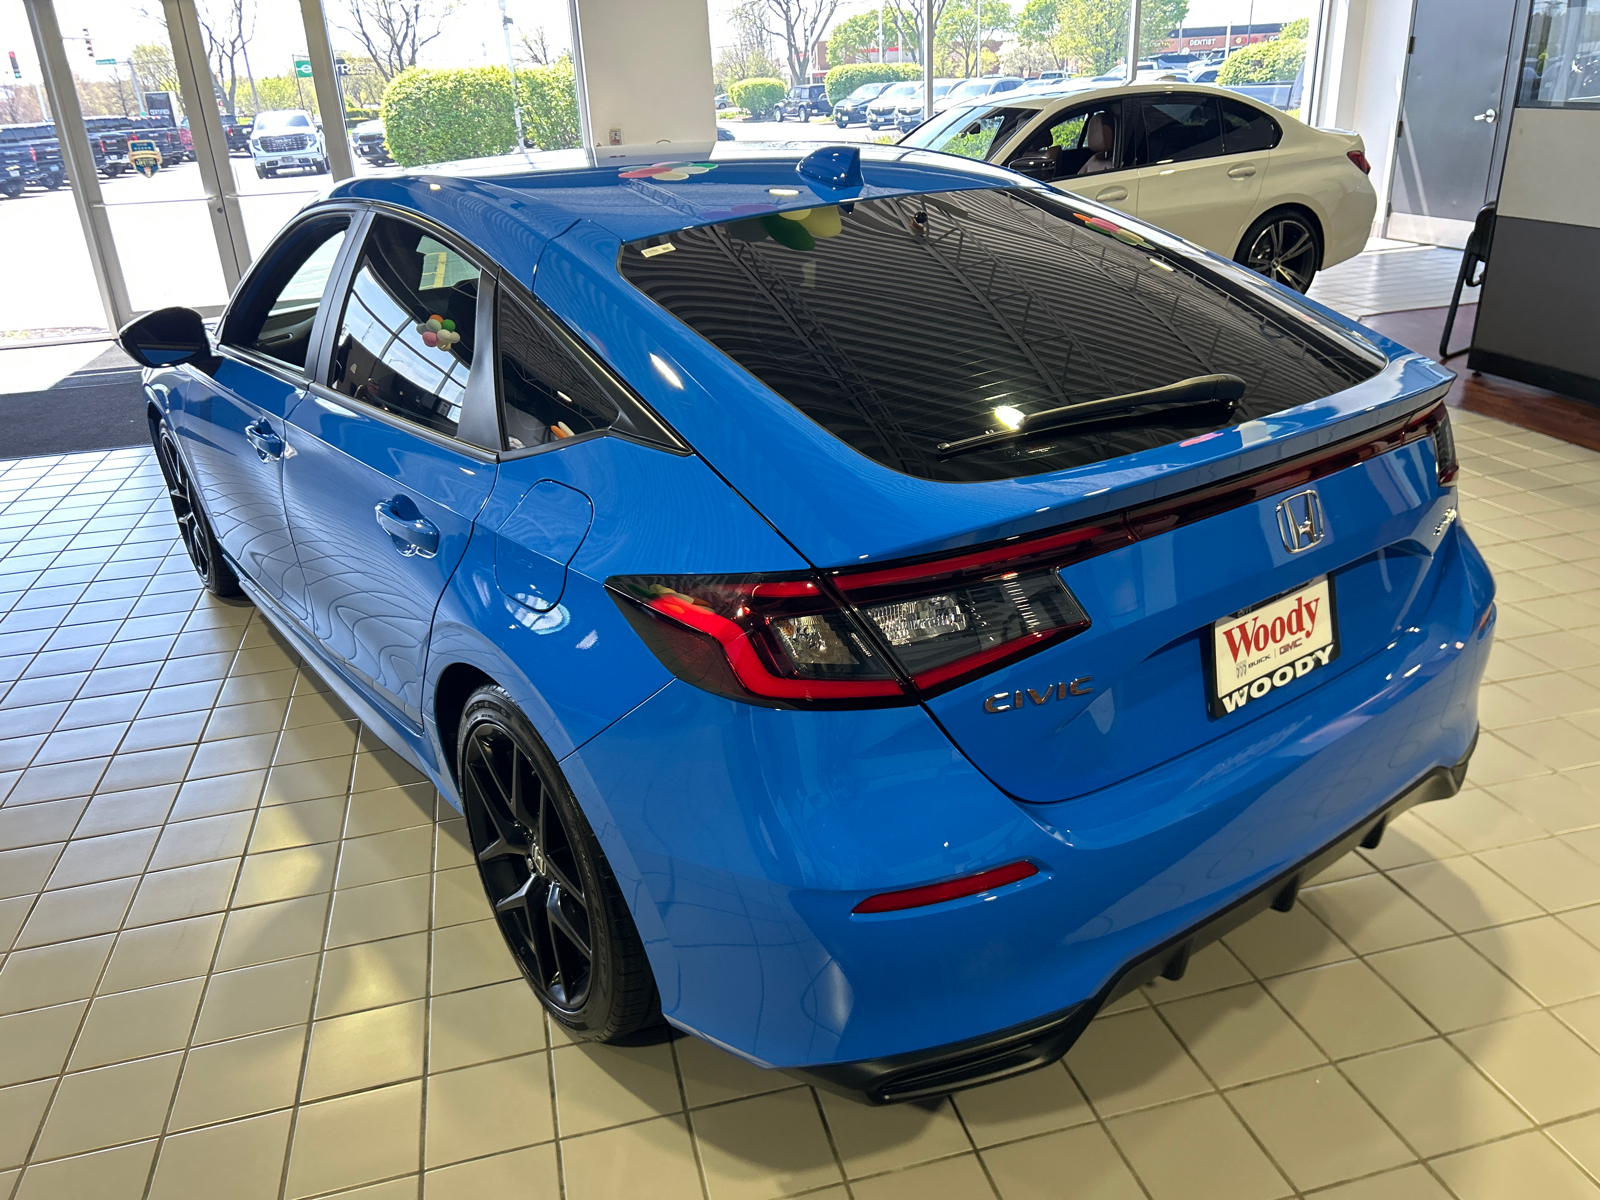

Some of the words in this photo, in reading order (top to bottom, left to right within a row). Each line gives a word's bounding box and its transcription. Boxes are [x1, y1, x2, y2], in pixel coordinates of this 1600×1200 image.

[1189, 38, 1216, 46] DENTIST
[1222, 596, 1320, 664] Woody
[1248, 655, 1271, 669] BUICK
[1279, 638, 1303, 656] GMC
[985, 676, 1093, 712] CIVIC
[1222, 644, 1334, 714] WOODY
